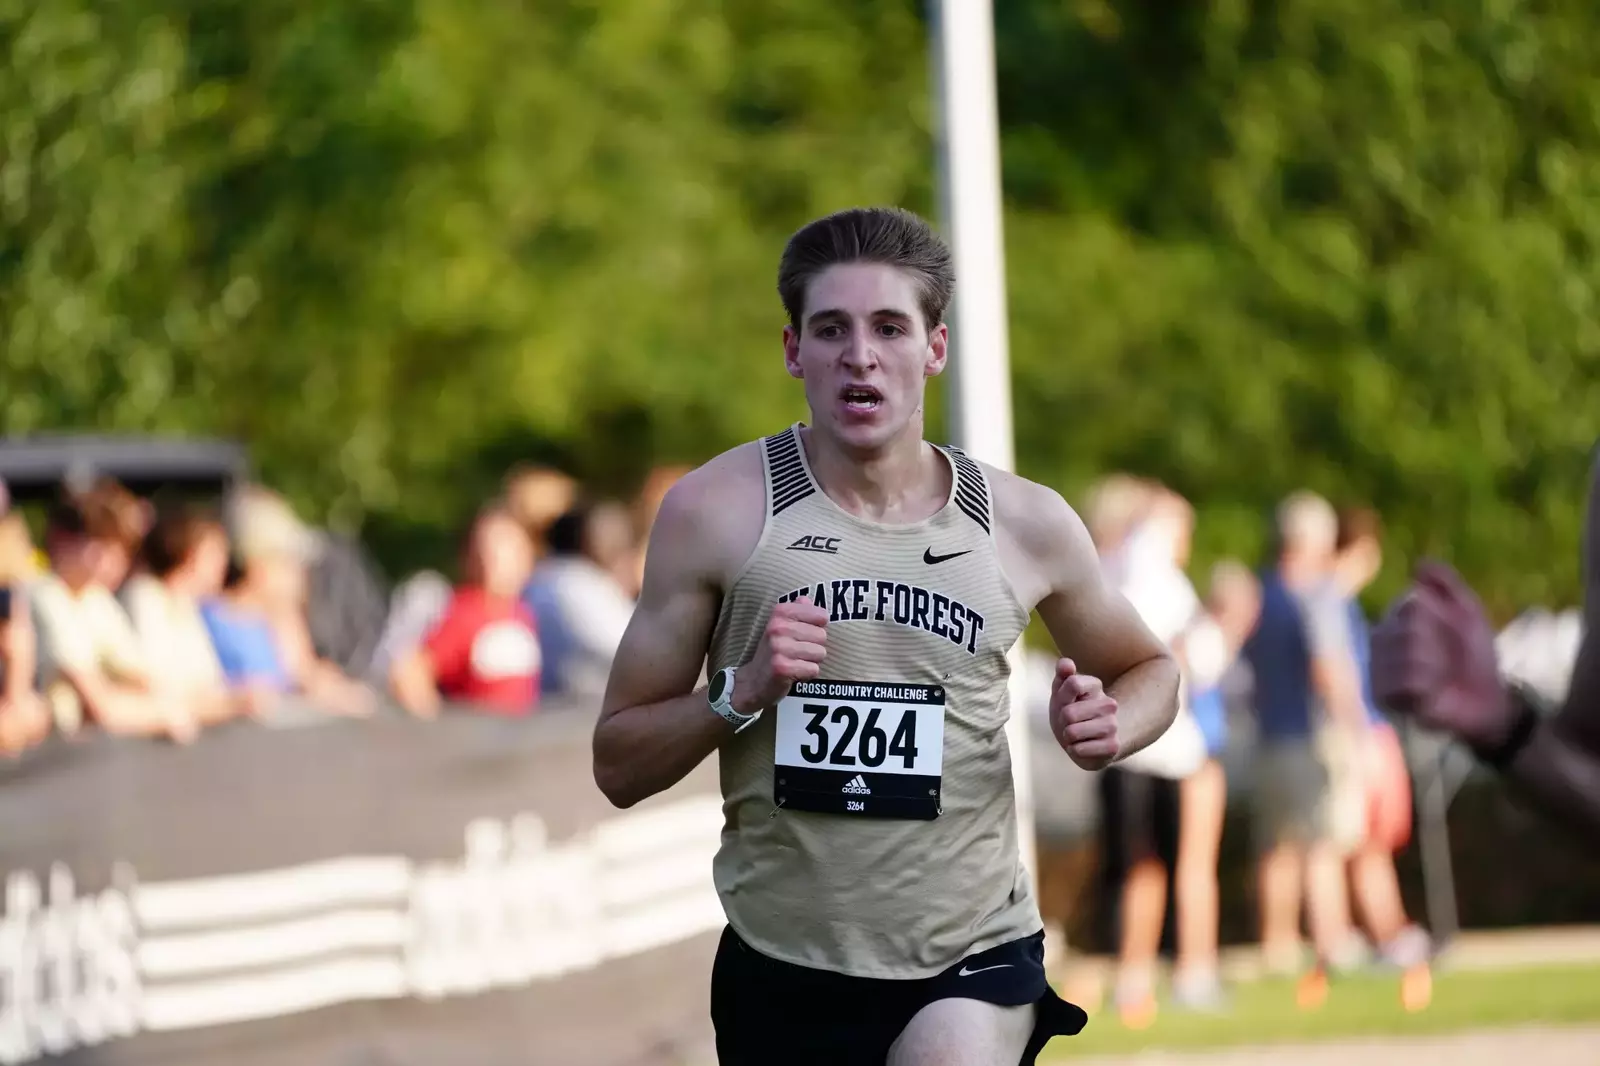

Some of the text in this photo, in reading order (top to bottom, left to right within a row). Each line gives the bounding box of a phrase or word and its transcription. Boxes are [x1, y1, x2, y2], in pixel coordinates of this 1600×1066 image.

[791, 535, 842, 551] ACC
[873, 580, 985, 655] FOREST
[795, 682, 928, 701] CROSS COUNTRY CHALLENGE
[800, 703, 918, 769] 3264
[841, 786, 871, 795] adidas
[846, 801, 865, 811] 3264
